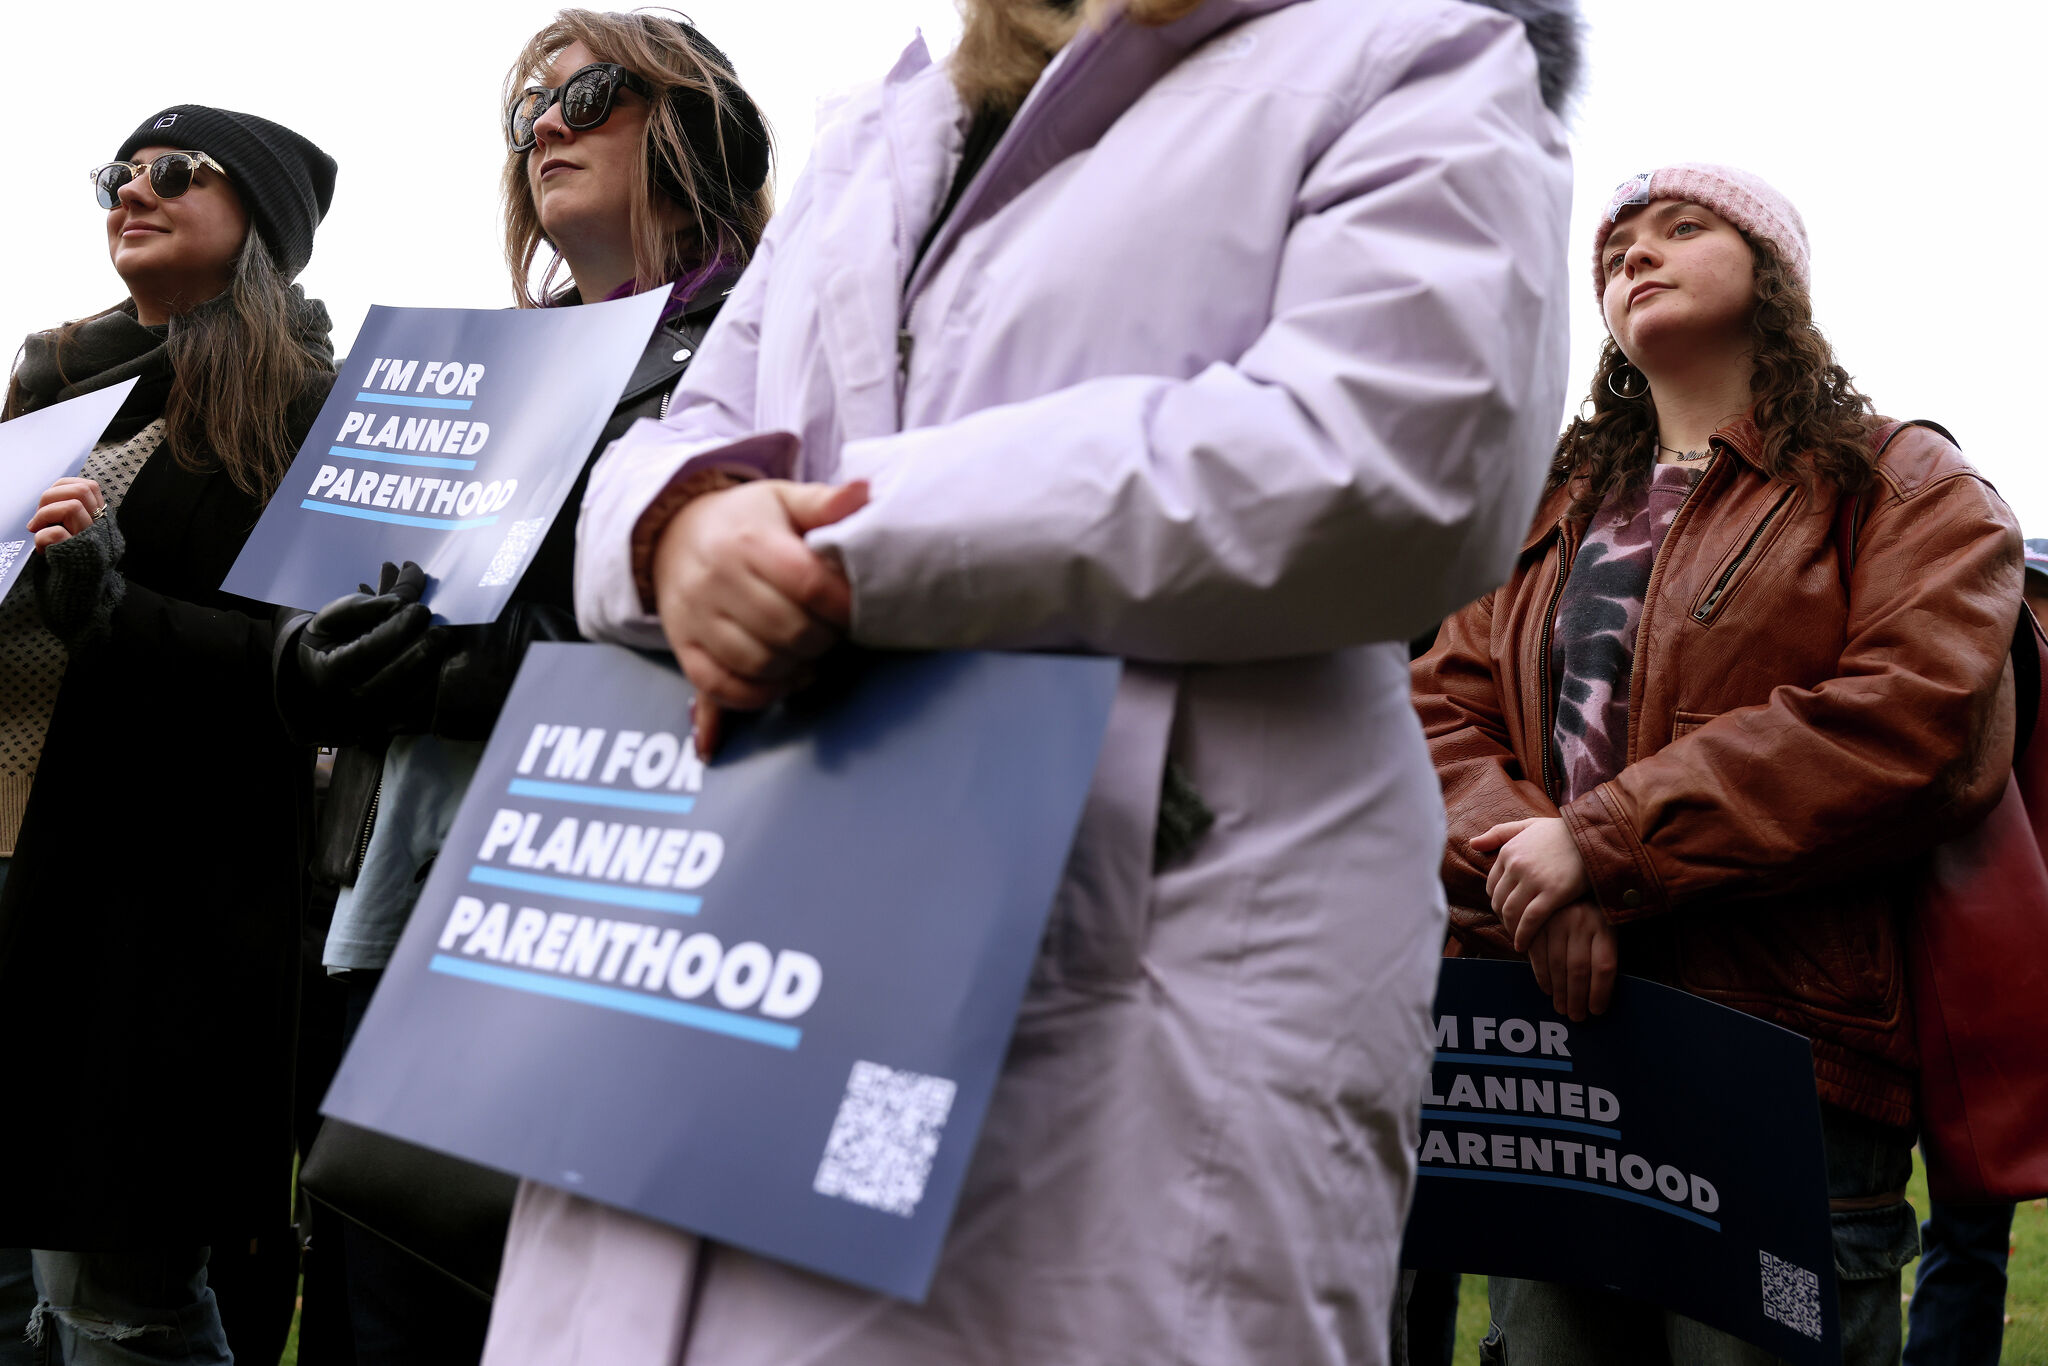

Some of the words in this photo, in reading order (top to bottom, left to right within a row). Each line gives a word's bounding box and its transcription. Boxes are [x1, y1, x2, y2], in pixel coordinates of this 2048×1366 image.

[362, 358, 416, 393] I'M
[417, 361, 485, 396] FOR
[336, 411, 490, 455] PLANNED
[307, 465, 518, 517] PARENTHOOD
[517, 724, 606, 780] I'M
[478, 808, 725, 889] PLANNED
[438, 896, 823, 1019] PARENTHOOD
[1472, 1016, 1572, 1057] FOR
[1421, 1072, 1620, 1123] LANNED
[1412, 1130, 1720, 1213] ARENTHOOD
